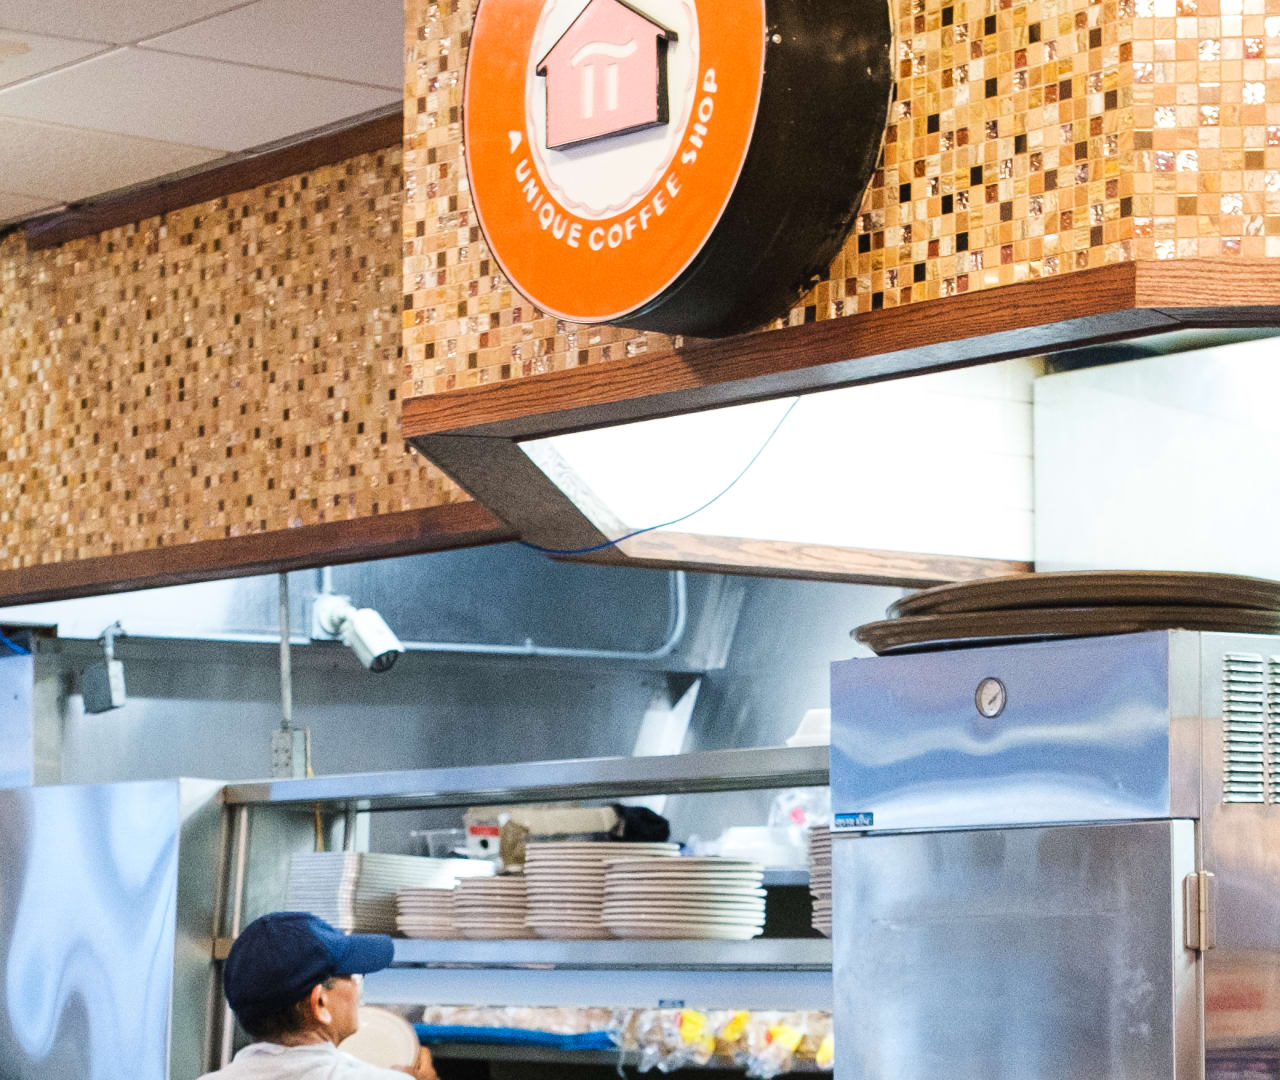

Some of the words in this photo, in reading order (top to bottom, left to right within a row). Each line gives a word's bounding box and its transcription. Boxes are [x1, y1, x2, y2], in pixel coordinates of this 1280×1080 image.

[508, 129, 522, 154] A
[515, 158, 582, 248] UNIQUE
[588, 171, 682, 251] COFFEE
[681, 68, 719, 165] SHOP
